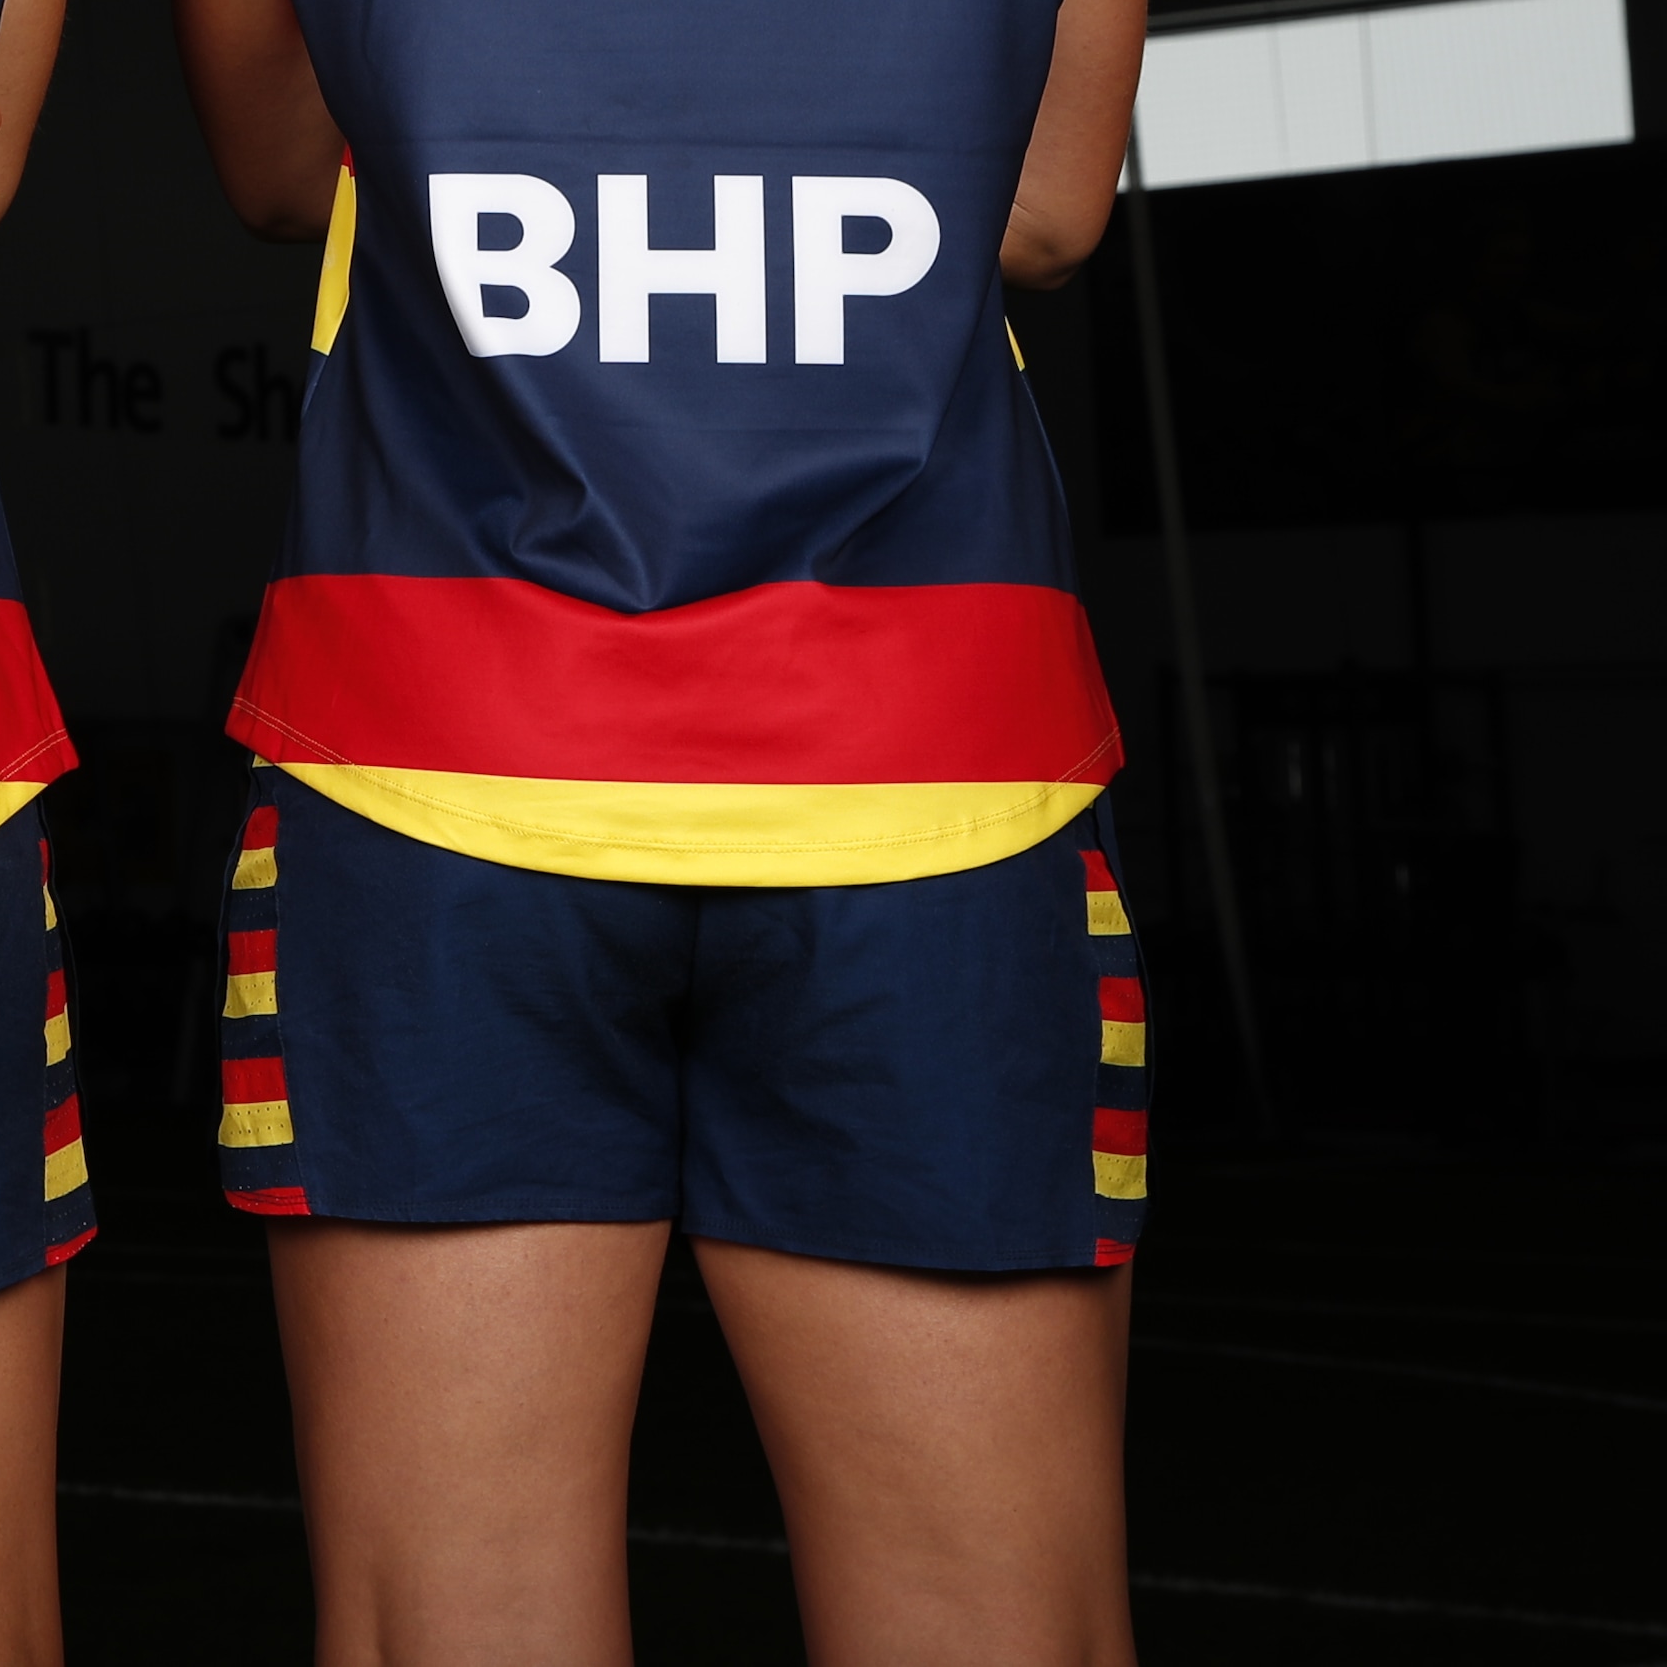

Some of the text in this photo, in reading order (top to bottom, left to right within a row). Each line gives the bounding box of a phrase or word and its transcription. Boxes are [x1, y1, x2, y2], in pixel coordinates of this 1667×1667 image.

[429, 174, 940, 364] BHP
[28, 328, 305, 442] The Sh
